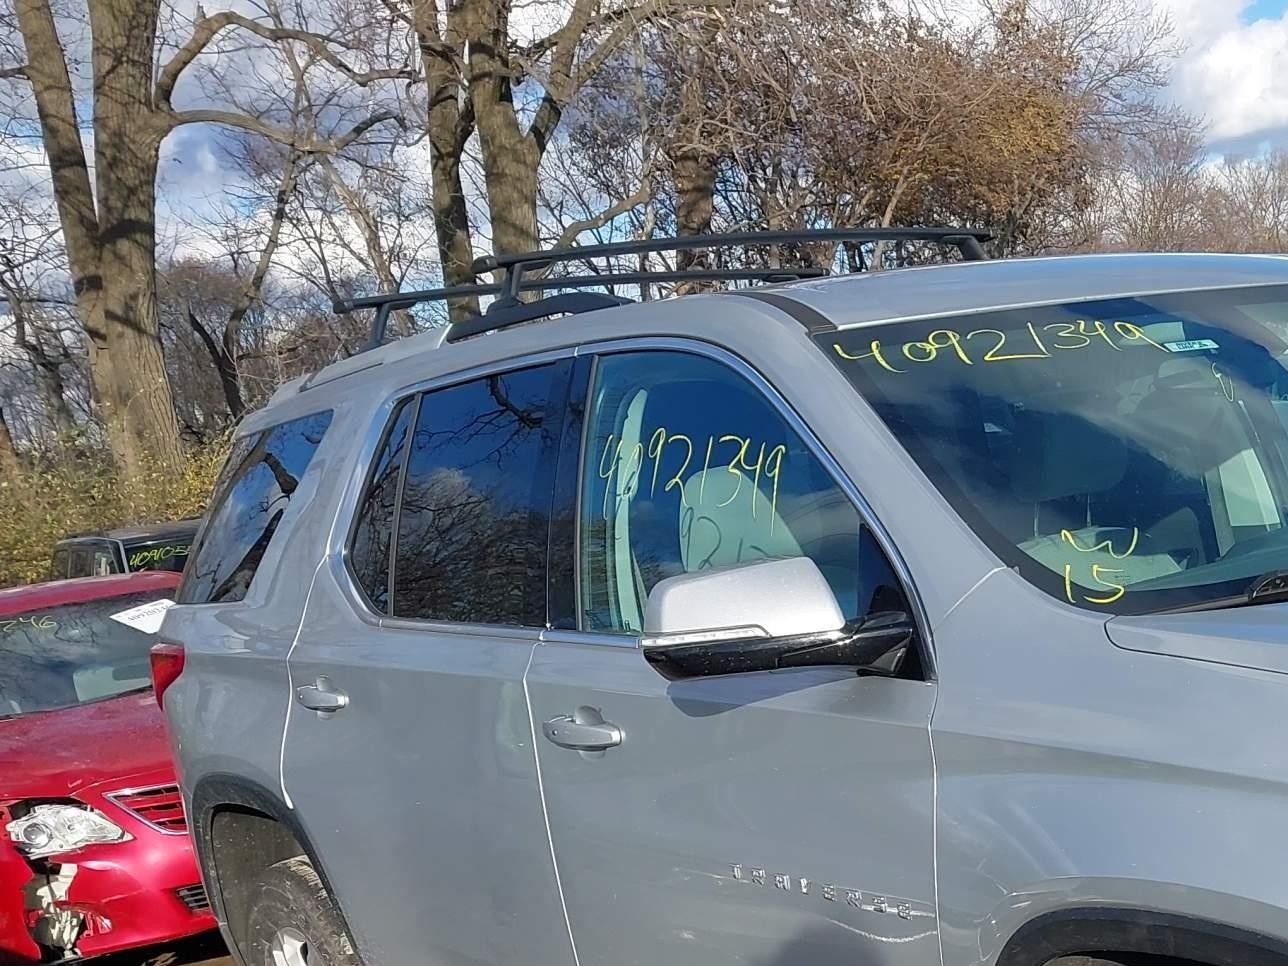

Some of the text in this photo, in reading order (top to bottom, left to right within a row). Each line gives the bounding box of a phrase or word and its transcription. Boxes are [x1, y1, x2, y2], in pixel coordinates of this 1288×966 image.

[833, 320, 1170, 374] 40921349
[599, 427, 787, 538] 40921349
[1064, 563, 1125, 604] 15
